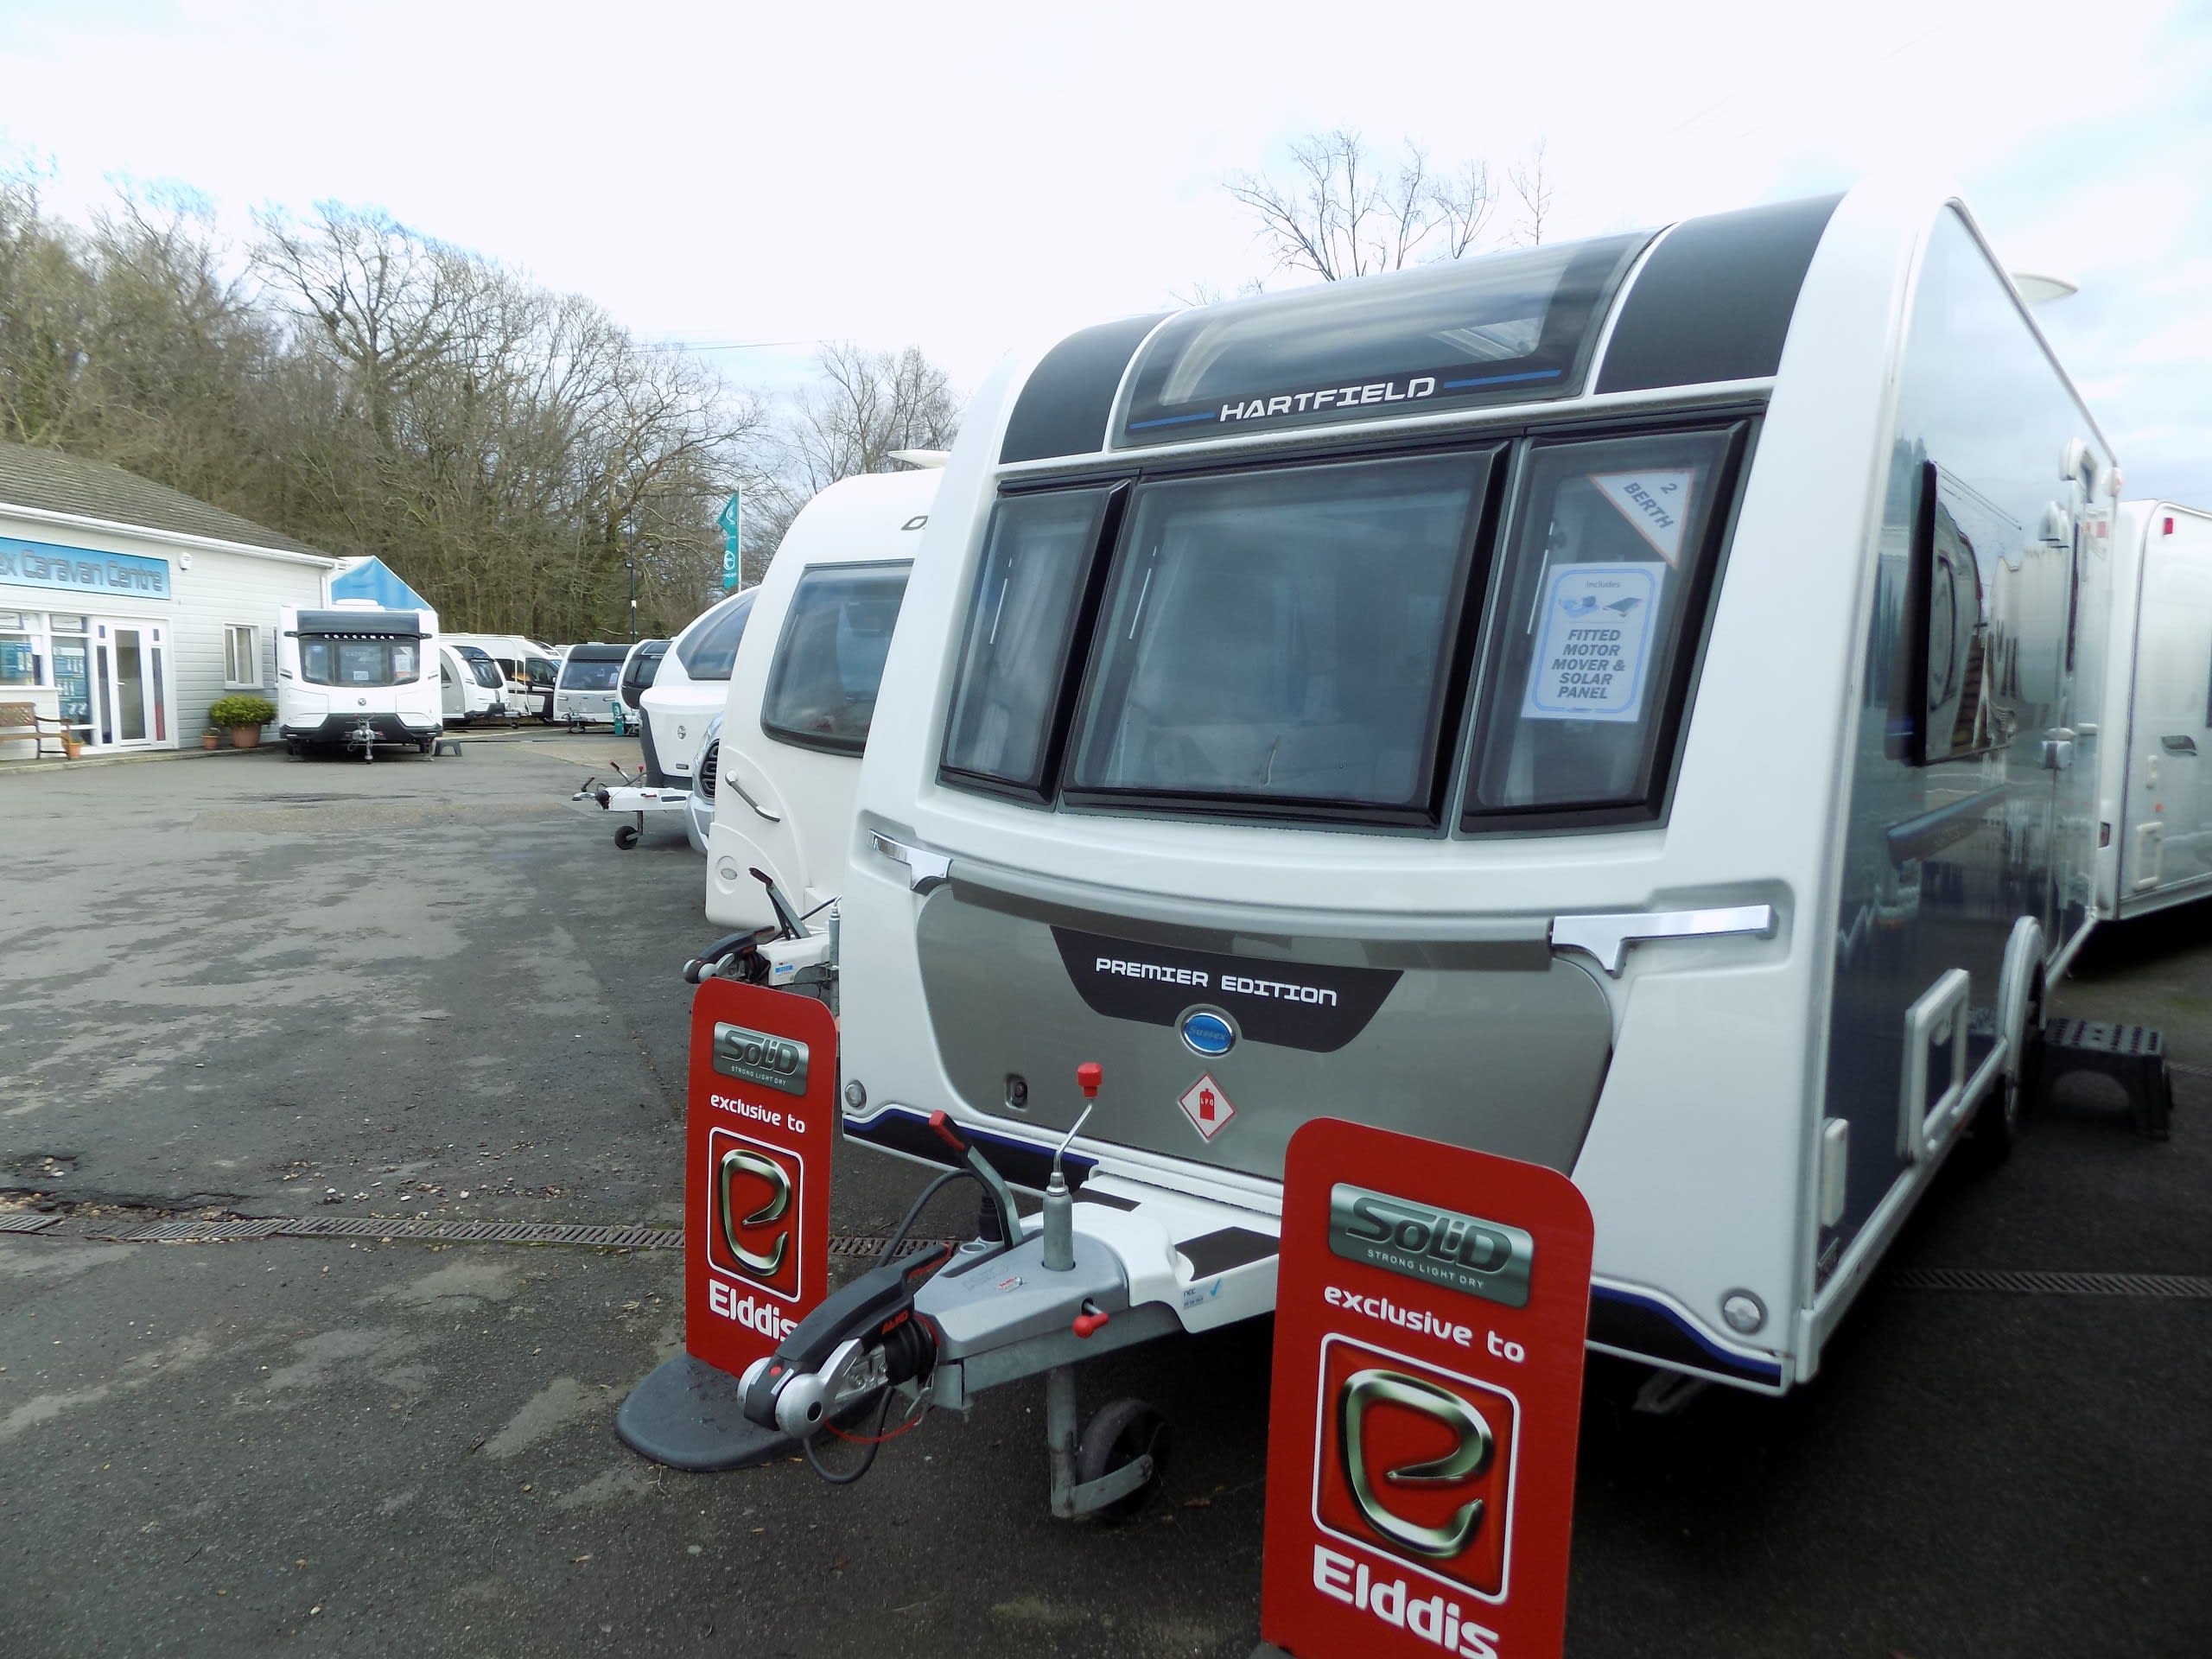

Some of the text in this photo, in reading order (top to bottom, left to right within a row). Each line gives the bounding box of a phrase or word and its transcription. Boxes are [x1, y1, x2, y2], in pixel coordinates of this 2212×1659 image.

[1219, 377, 1436, 423] HARTFIELD
[1624, 482, 1675, 529] BERTH
[1659, 483, 1678, 495] 2
[21, 549, 104, 586] Caravan
[107, 560, 162, 592] Centre
[1562, 644, 1621, 657] MOTOR
[1567, 629, 1621, 641] FITTED
[1552, 658, 1625, 671] MOVER &
[1559, 672, 1613, 685] SOLAR
[1557, 686, 1608, 699] PANEL
[1096, 957, 1337, 1007] PREMIER EDITION
[731, 1065, 787, 1086] STRONG LIGHT DRY
[710, 1094, 806, 1134] exclusive to
[1367, 1249, 1484, 1288] STRONG LIGHT DRY
[1324, 1285, 1525, 1363] exclusive to
[1313, 1543, 1500, 1659] Elddis
